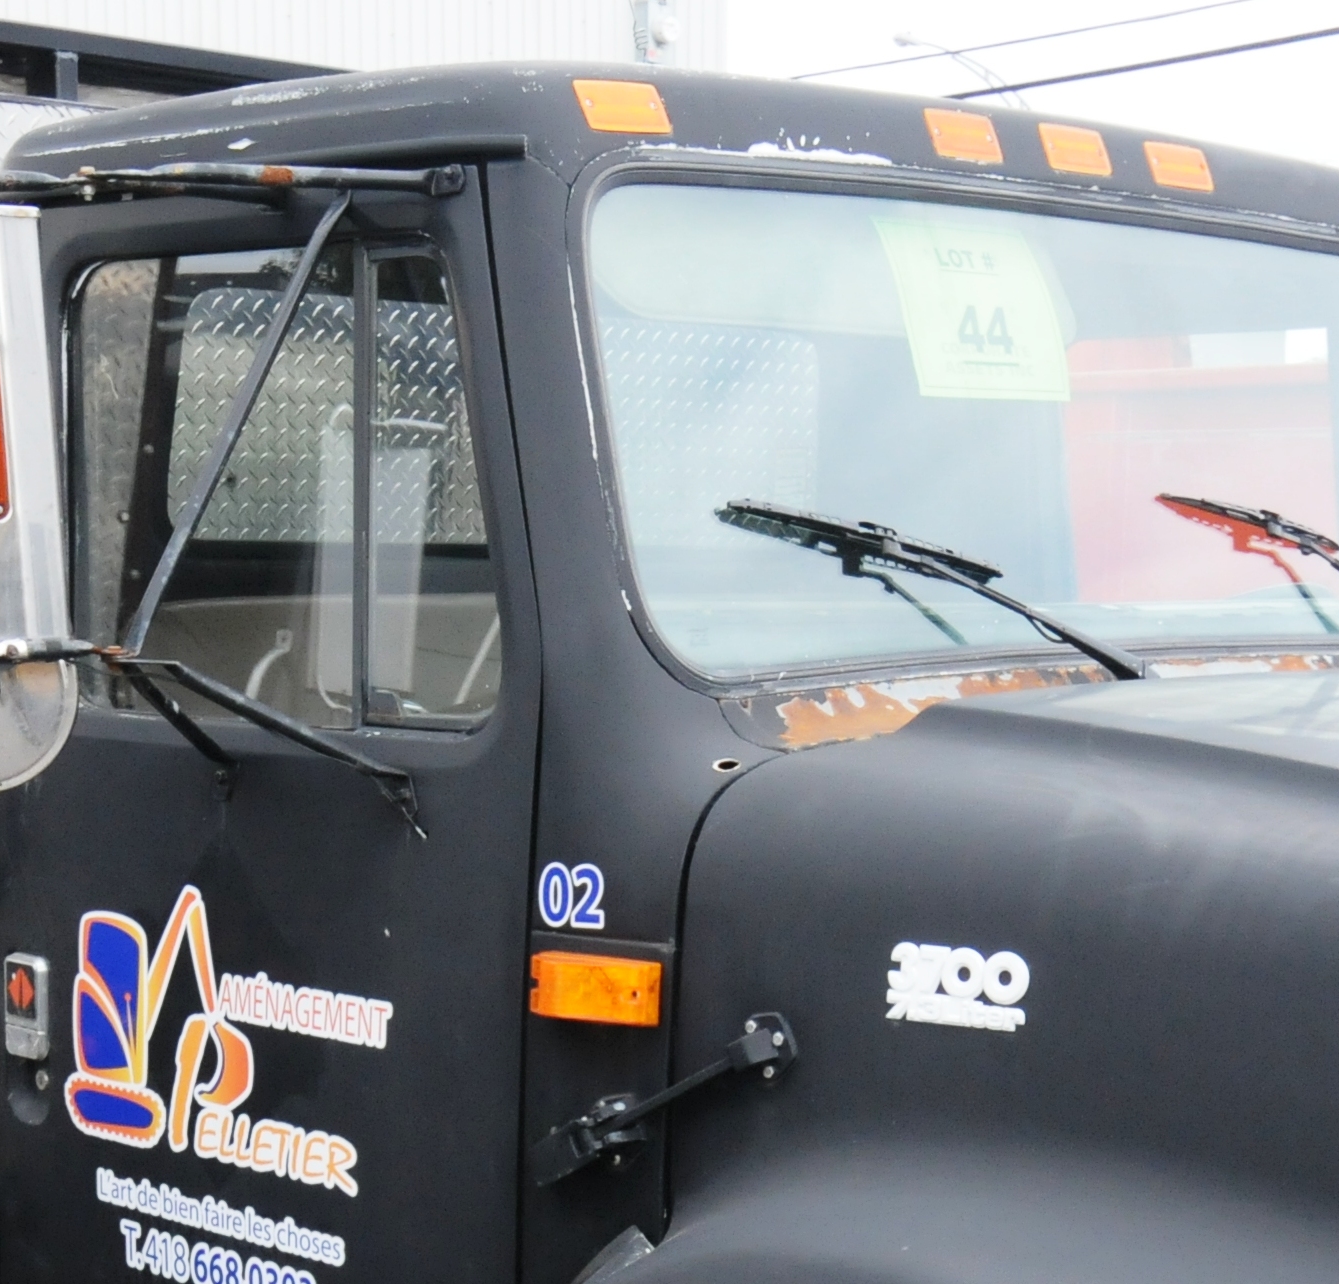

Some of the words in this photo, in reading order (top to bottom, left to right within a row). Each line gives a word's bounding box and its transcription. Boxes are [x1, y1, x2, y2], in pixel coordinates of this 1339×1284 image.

[933, 246, 975, 269] LOT
[957, 304, 1014, 355] 44
[539, 861, 604, 929] 02
[887, 941, 1030, 1006] 3700
[217, 976, 390, 1045] AMÉNAGEMENT
[98, 1169, 134, 1206] L'art
[137, 1181, 160, 1212] de
[162, 1186, 201, 1225] bien
[203, 1197, 244, 1236] faire
[247, 1208, 273, 1244] les
[275, 1219, 343, 1263] choses
